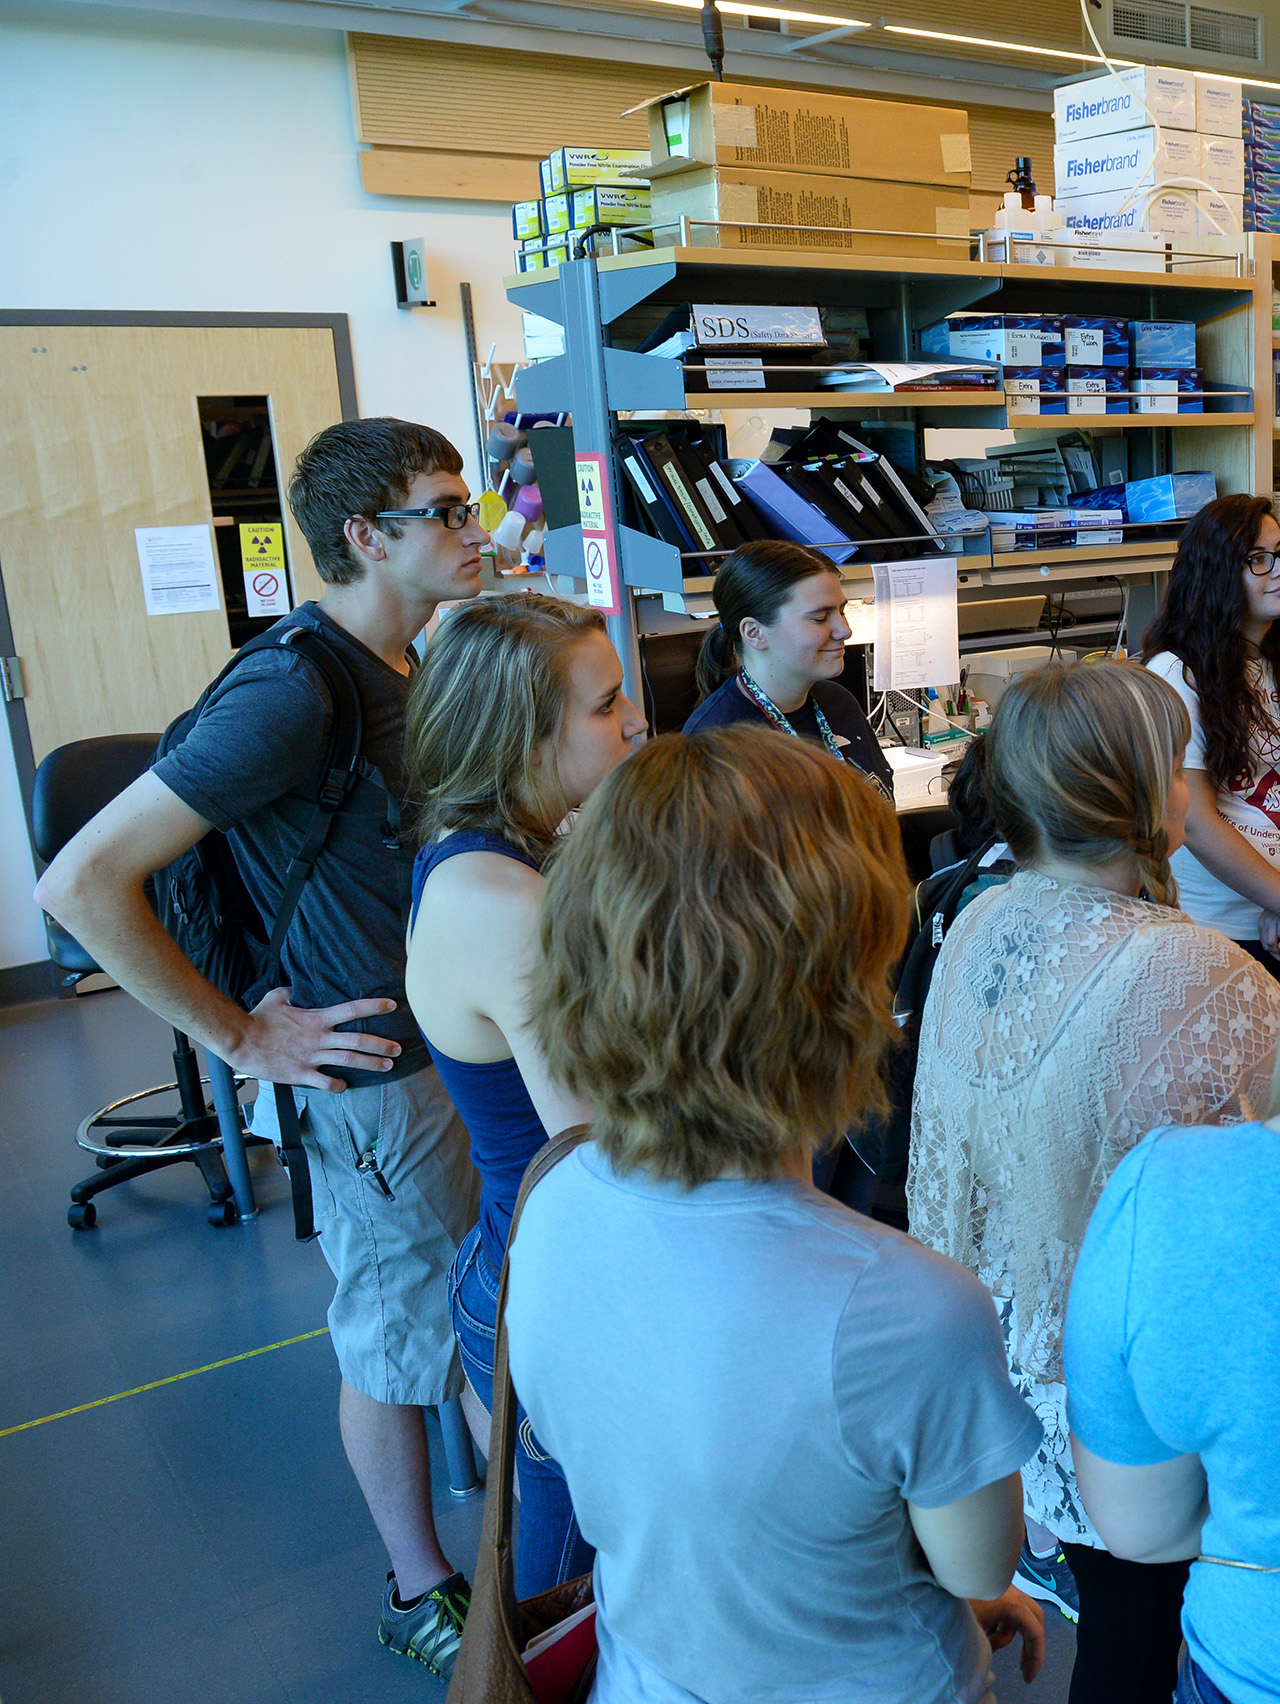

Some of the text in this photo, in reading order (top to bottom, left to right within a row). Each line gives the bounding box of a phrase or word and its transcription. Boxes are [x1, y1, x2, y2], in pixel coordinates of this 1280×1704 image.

[1066, 94, 1131, 122] Fisherbrand
[1067, 149, 1138, 178] Fisherbrand
[702, 317, 750, 338] SDS
[1081, 333, 1094, 341] Extra
[1018, 382, 1033, 390] Extra
